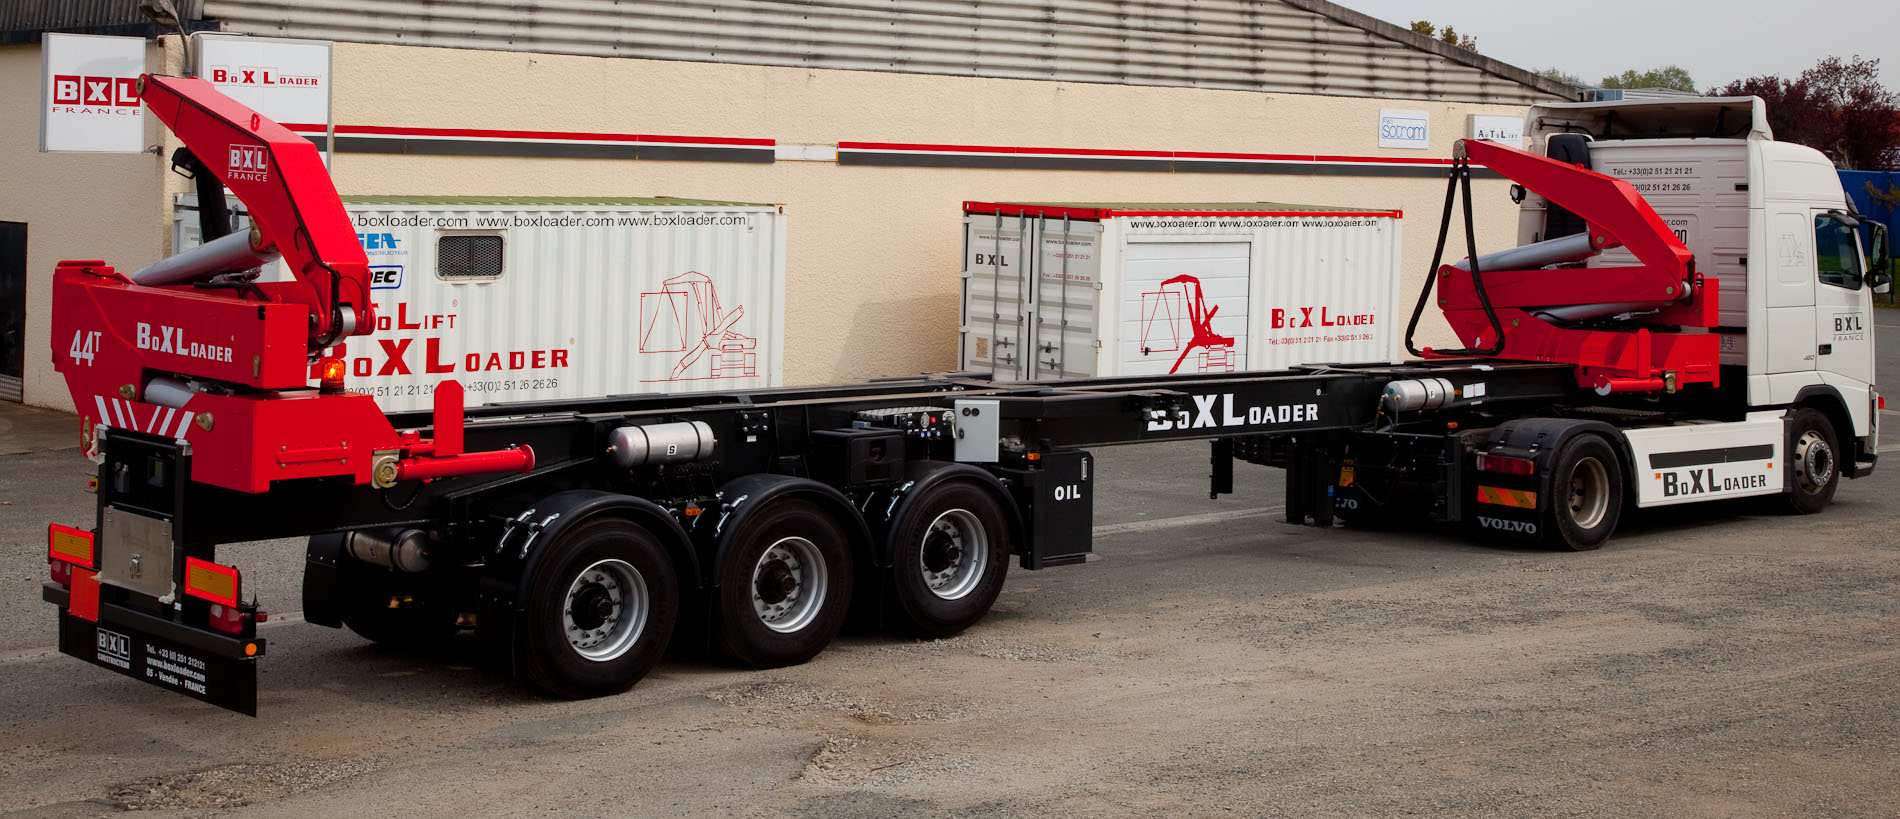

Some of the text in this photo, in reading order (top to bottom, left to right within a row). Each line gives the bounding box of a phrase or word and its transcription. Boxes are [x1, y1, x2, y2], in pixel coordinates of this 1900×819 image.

[57, 79, 138, 103] BXL
[52, 106, 141, 116] FRANCE
[230, 149, 267, 169] BXL
[228, 171, 268, 182] FRANCE
[350, 214, 746, 227] .boxloader.com www.boxloader.com www.boxloader.com
[1835, 317, 1862, 331] BXL
[377, 386, 390, 397] 51
[394, 386, 403, 396] 21
[407, 385, 420, 396] 21
[423, 385, 433, 395] 21
[504, 381, 516, 391] 51
[533, 379, 544, 390] 26
[546, 378, 558, 389] 26
[1055, 485, 1080, 501] OIL
[1477, 515, 1537, 534] VOLVO
[98, 631, 129, 655] BXL
[146, 656, 206, 682] www.boxloader.com
[184, 679, 207, 695] FRANCE
